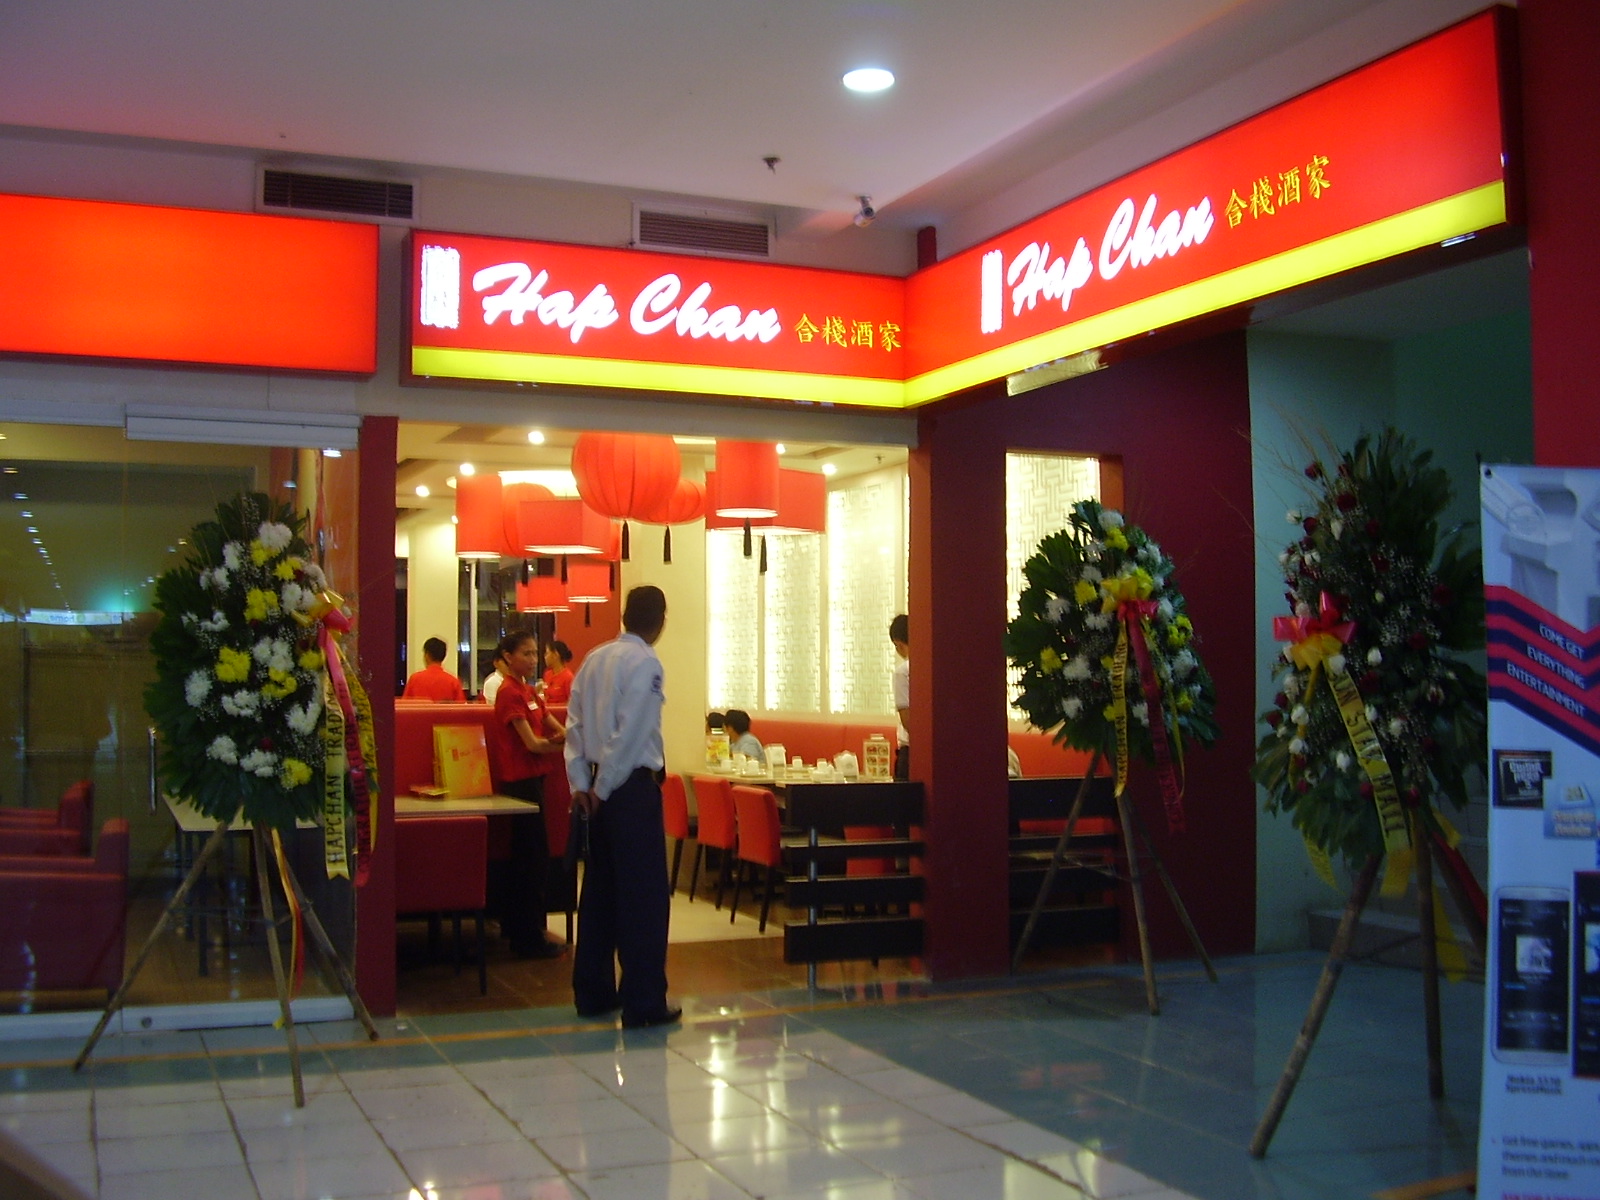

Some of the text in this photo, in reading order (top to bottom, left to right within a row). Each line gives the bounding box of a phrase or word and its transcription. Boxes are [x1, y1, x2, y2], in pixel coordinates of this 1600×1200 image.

[1006, 193, 1216, 316] Hap Chan
[472, 261, 783, 343] Hap Chan
[1527, 643, 1586, 690] EVERYTHING
[1539, 622, 1585, 660] COME GET
[1506, 660, 1586, 718] ENTERTAINMENT
[326, 774, 343, 865] HAPCHAN
